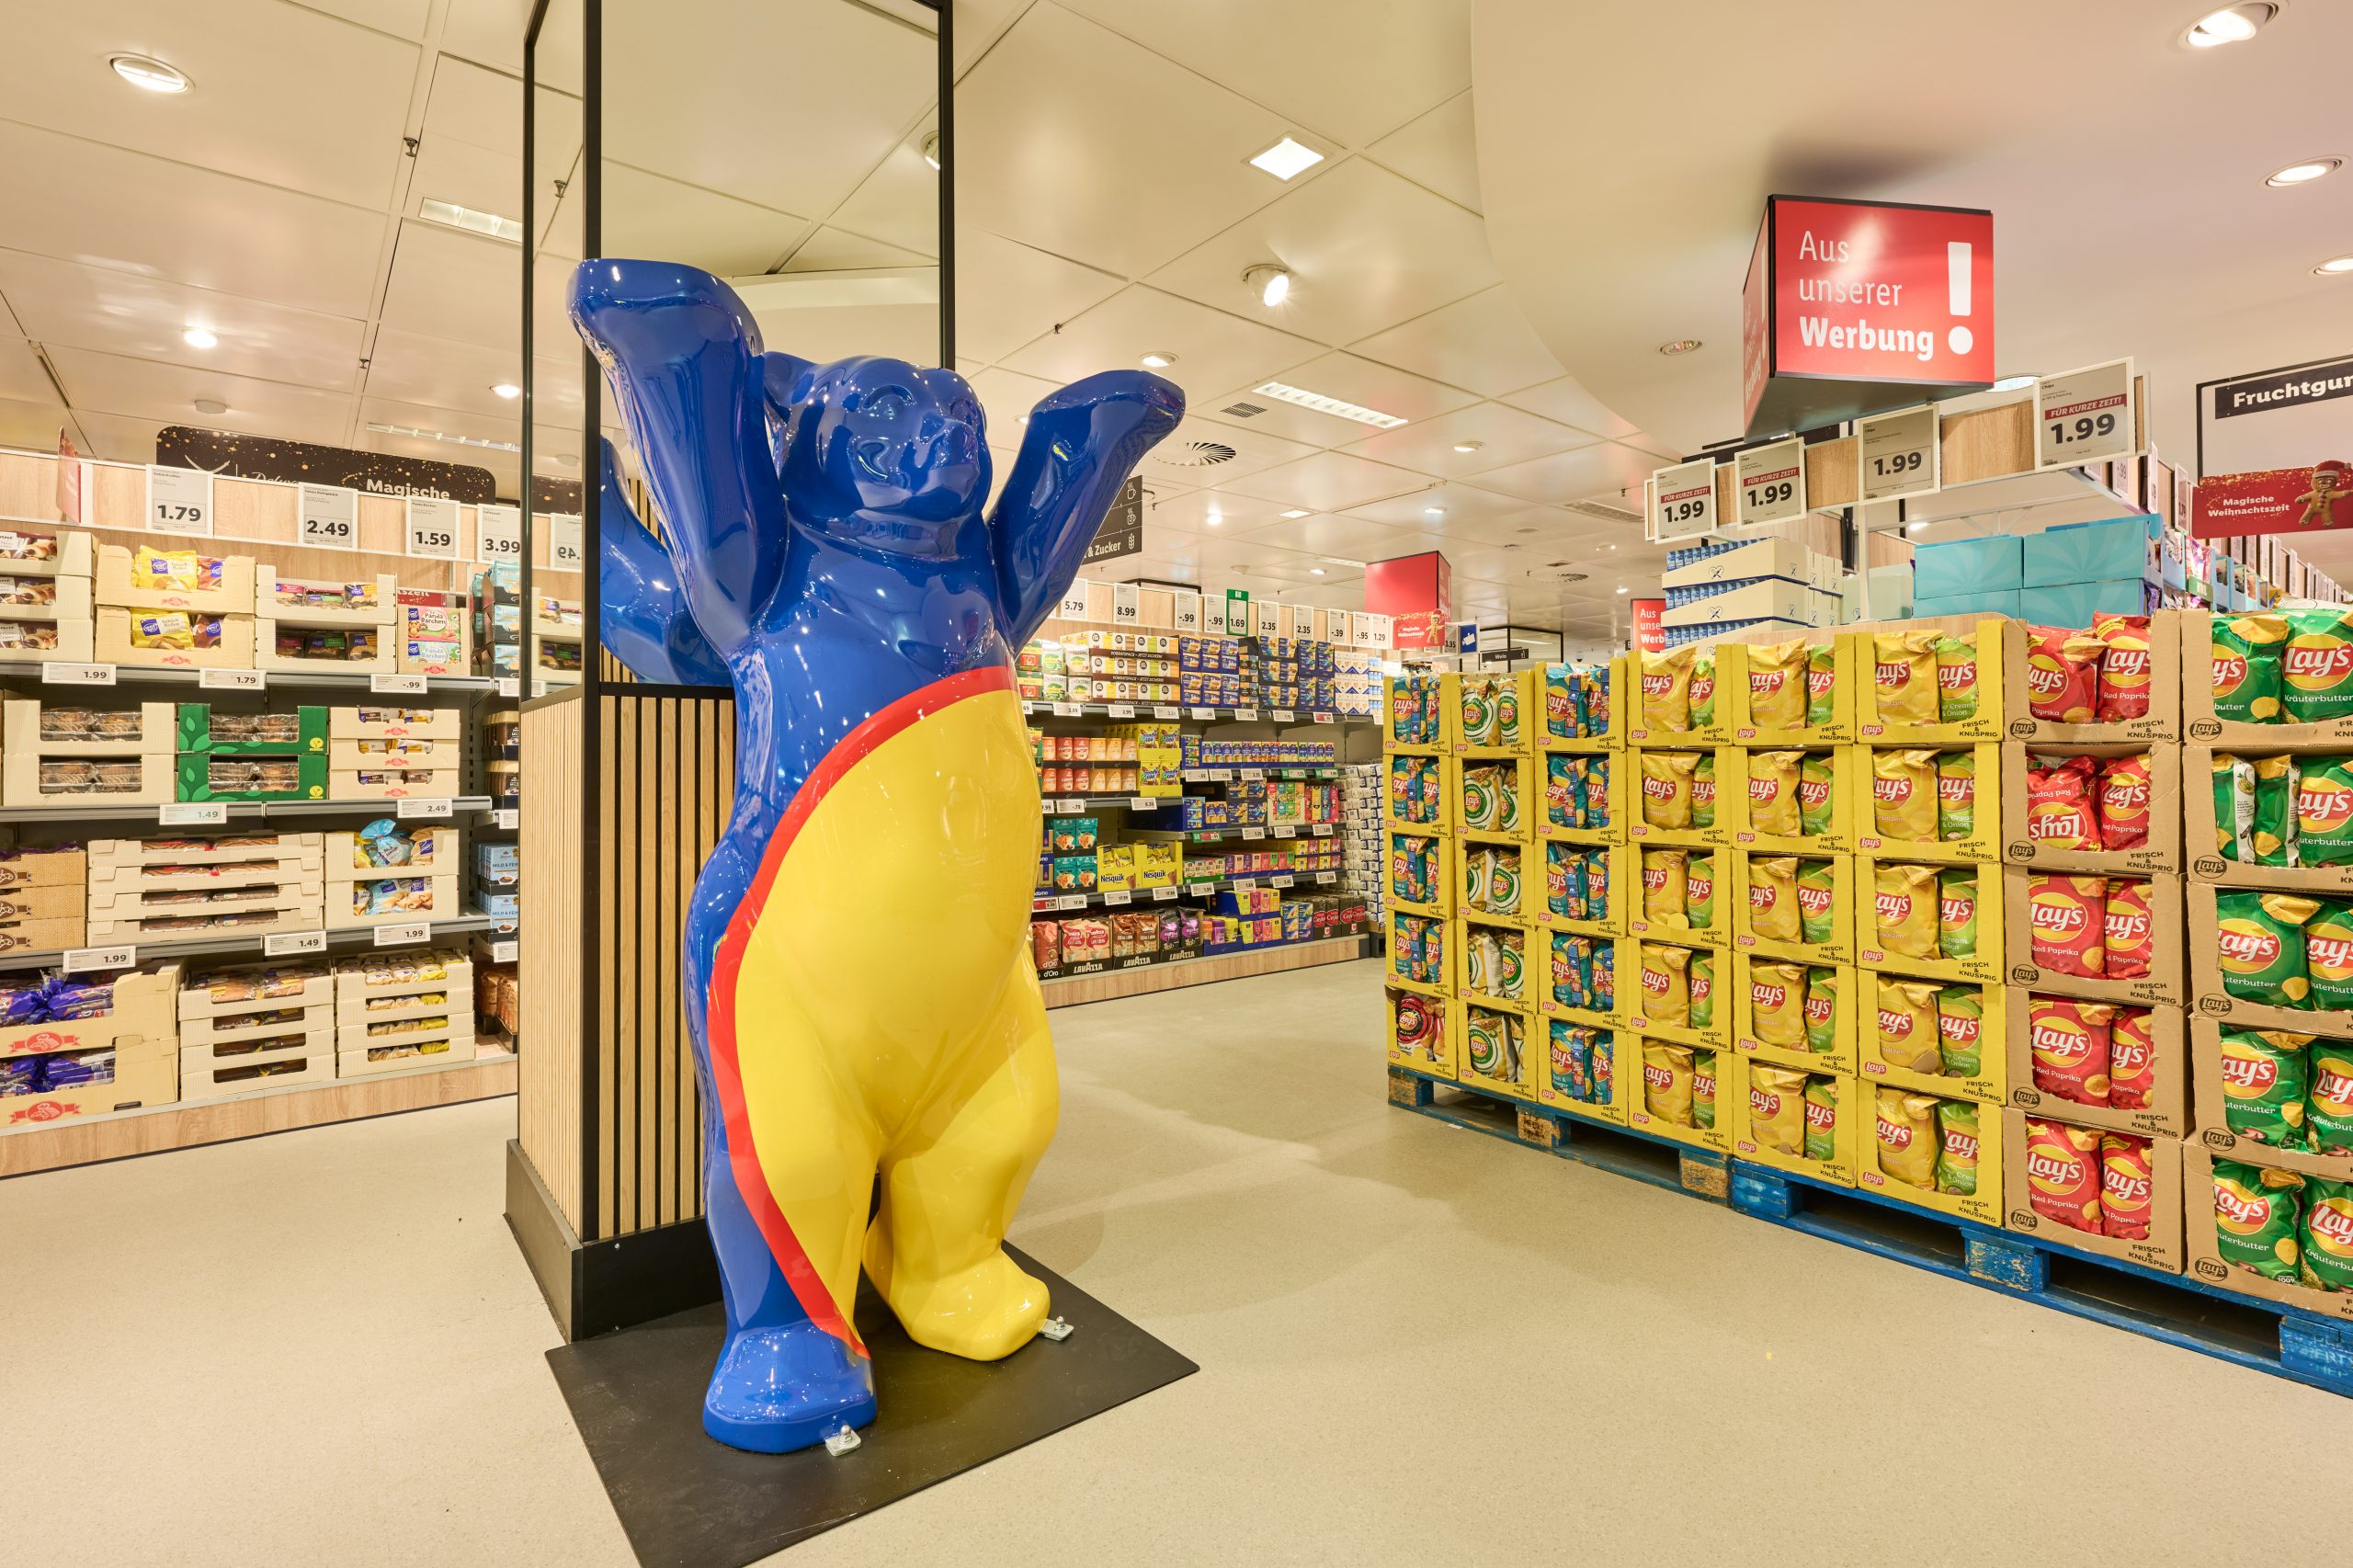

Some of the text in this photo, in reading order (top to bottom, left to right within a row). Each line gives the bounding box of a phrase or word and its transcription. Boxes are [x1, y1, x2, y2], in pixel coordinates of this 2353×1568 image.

[1799, 231, 1849, 263] Aus
[1799, 278, 1902, 306] unserer
[1799, 316, 1933, 361] Werbung
[2051, 396, 2121, 417] FÜR KURZE ZEIT!
[2051, 414, 2115, 444] 1.99
[1874, 452, 1921, 475] 1.99
[1747, 469, 1797, 485] FÜR KURZE ZEIT!
[367, 479, 450, 500] Magische
[1664, 487, 1708, 502] FÜR KURZE ZEIT!
[1748, 483, 1792, 507] 1.99
[2223, 495, 2274, 506] Magische
[157, 505, 201, 521] 1.79
[1665, 501, 1704, 522] 1.99
[2208, 504, 2290, 517] Weihnachtszeit
[307, 520, 349, 536] 2.49
[415, 531, 450, 546] 1.59
[485, 539, 520, 553] 3.99
[1088, 541, 1121, 557] & Zucker
[1065, 601, 1083, 610] 5.79
[1117, 607, 1135, 617] 8.99
[1179, 614, 1194, 622] -.99
[1640, 608, 1655, 618] Aus
[1209, 617, 1222, 625] -.99
[1231, 619, 1245, 627] 1.69
[1262, 622, 1276, 631] 2.35
[1641, 634, 1664, 643] Werb
[2285, 645, 2351, 677] Lay's
[84, 671, 107, 679] 1.99
[1949, 702, 1974, 710] Cream
[2031, 707, 2060, 716] Paprika
[1464, 708, 1481, 721] Lay's
[1949, 709, 1968, 717] Onion
[1821, 724, 1845, 733] FRISCH
[1863, 724, 1883, 735] Lay's
[1962, 720, 1989, 729] FRISCH
[2013, 722, 2035, 735] Lay's
[2131, 720, 2165, 730] FRISCH
[2192, 722, 2221, 735] Lay's
[1819, 733, 1851, 741] KNUSPRIG
[1959, 729, 1998, 737] KNUSPRIG
[1643, 778, 1676, 801] Lay's
[2057, 789, 2072, 797] Red
[2103, 783, 2146, 809] Lay's
[195, 810, 219, 819] 1.49
[426, 804, 447, 813] 2.49
[2111, 824, 2143, 833] Paprika
[1860, 838, 1881, 847] Lay's
[1955, 850, 1994, 859] KNUSPRIG
[2011, 844, 2034, 858] Lay's
[2131, 851, 2164, 859] FRISCH
[2126, 862, 2174, 872] KNUSPRIG
[2196, 861, 2225, 873] Lay's
[1101, 873, 1124, 883] Nesquik
[1143, 869, 1165, 880] Nesquik
[2031, 902, 2083, 930] Lay's
[299, 938, 319, 948] 1.49
[1169, 950, 1195, 960] LAVAZZA
[1863, 951, 1883, 961] Lay's
[2031, 945, 2079, 957] Red Paprika
[104, 955, 127, 963] 1.99
[1123, 956, 1151, 967] LAVAZZA
[2113, 956, 2143, 964] Paprika
[1074, 962, 1103, 974] LAVAZZA
[2015, 968, 2037, 983] Lay's
[2130, 992, 2177, 1005] KNUSPRIG
[2202, 999, 2230, 1012] Lay's
[1399, 1014, 1416, 1026] Lay's
[1471, 1040, 1487, 1052] Lay's
[2032, 1025, 2087, 1057] Lay's
[1953, 1052, 1978, 1065] Cream
[2036, 1066, 2082, 1083] Red Paprika
[1962, 1088, 2001, 1102] KNUSPRIG
[2111, 1083, 2140, 1095] Paprika
[2016, 1091, 2039, 1106] Lay's
[1601, 1114, 1625, 1123] KNUSPRIG
[2306, 1112, 2353, 1131] Kräuterbut
[2131, 1121, 2177, 1138] KNUSPRIG
[2205, 1131, 2234, 1146] Lay's
[2029, 1153, 2081, 1184] Lay's
[1961, 1199, 1989, 1208] FRISCH
[2031, 1194, 2078, 1210] Red Paprika
[1958, 1207, 1996, 1223] KNUSPRIG
[2013, 1213, 2036, 1228] Lay's
[2132, 1244, 2165, 1255] FRISCH
[2128, 1252, 2176, 1271] KNUSPRIG
[2197, 1261, 2226, 1278] Lay's
